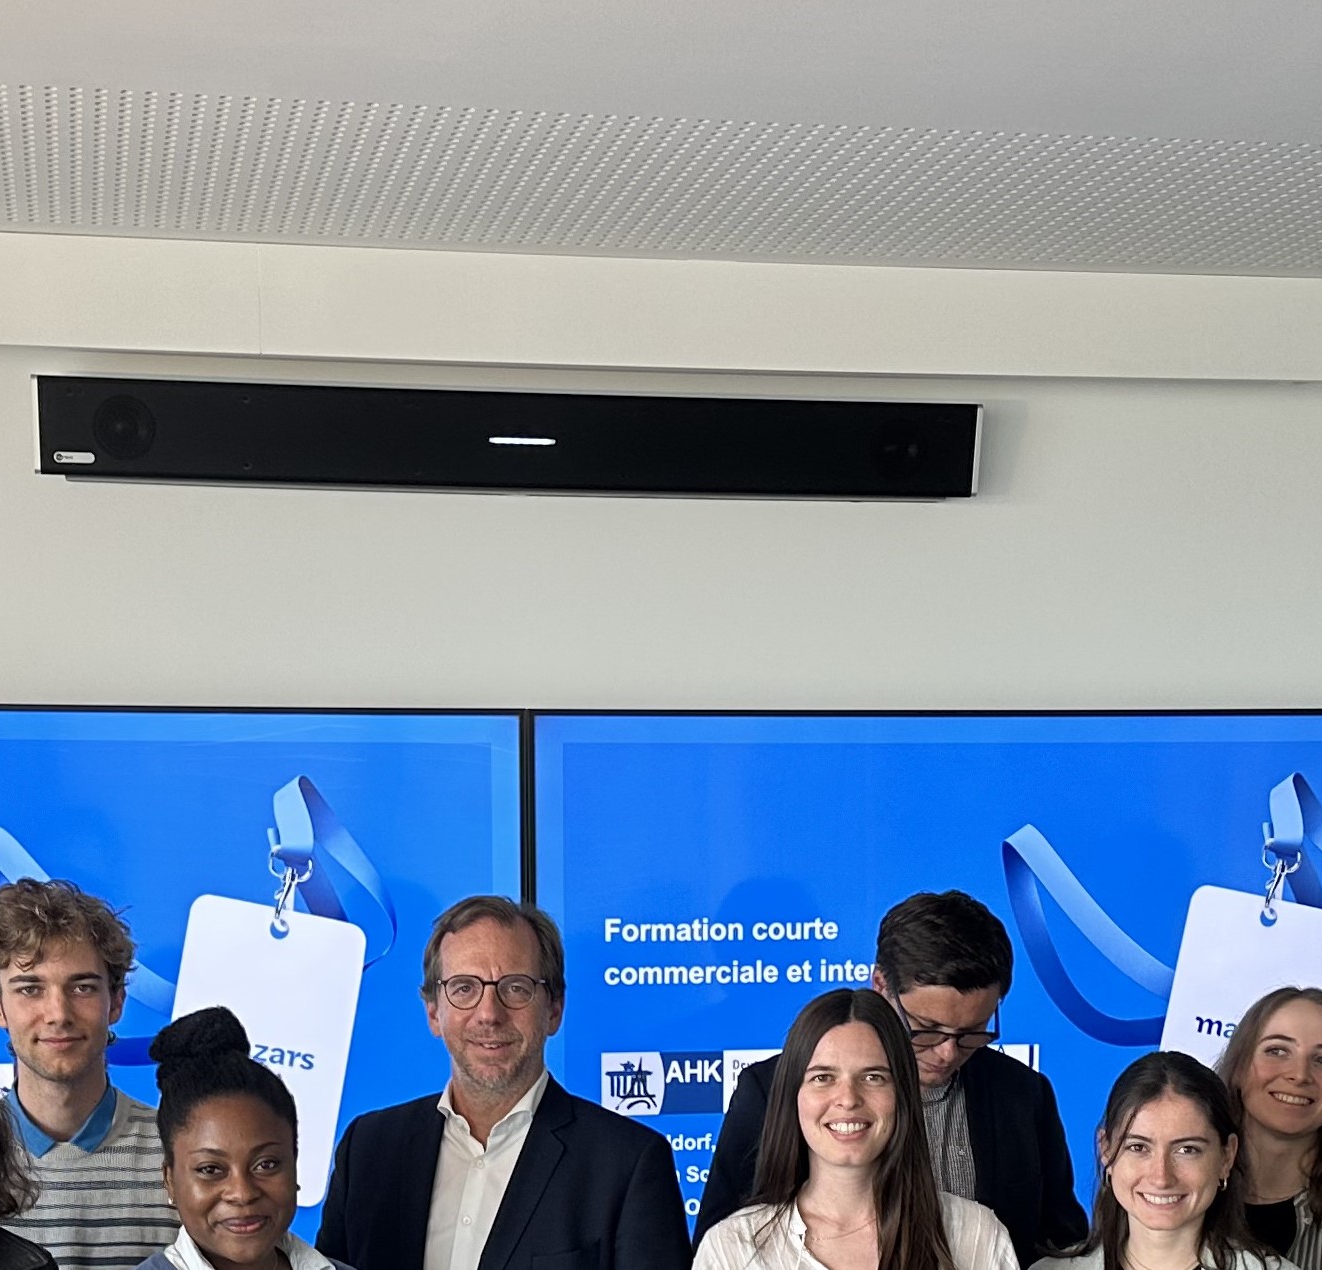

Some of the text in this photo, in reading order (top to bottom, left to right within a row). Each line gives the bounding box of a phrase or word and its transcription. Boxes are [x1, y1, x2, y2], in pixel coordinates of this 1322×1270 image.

[604, 918, 838, 942] Formation courte
[604, 960, 877, 985] commerciale et inter
[252, 1044, 315, 1070] zars
[665, 1059, 723, 1083] AHK
